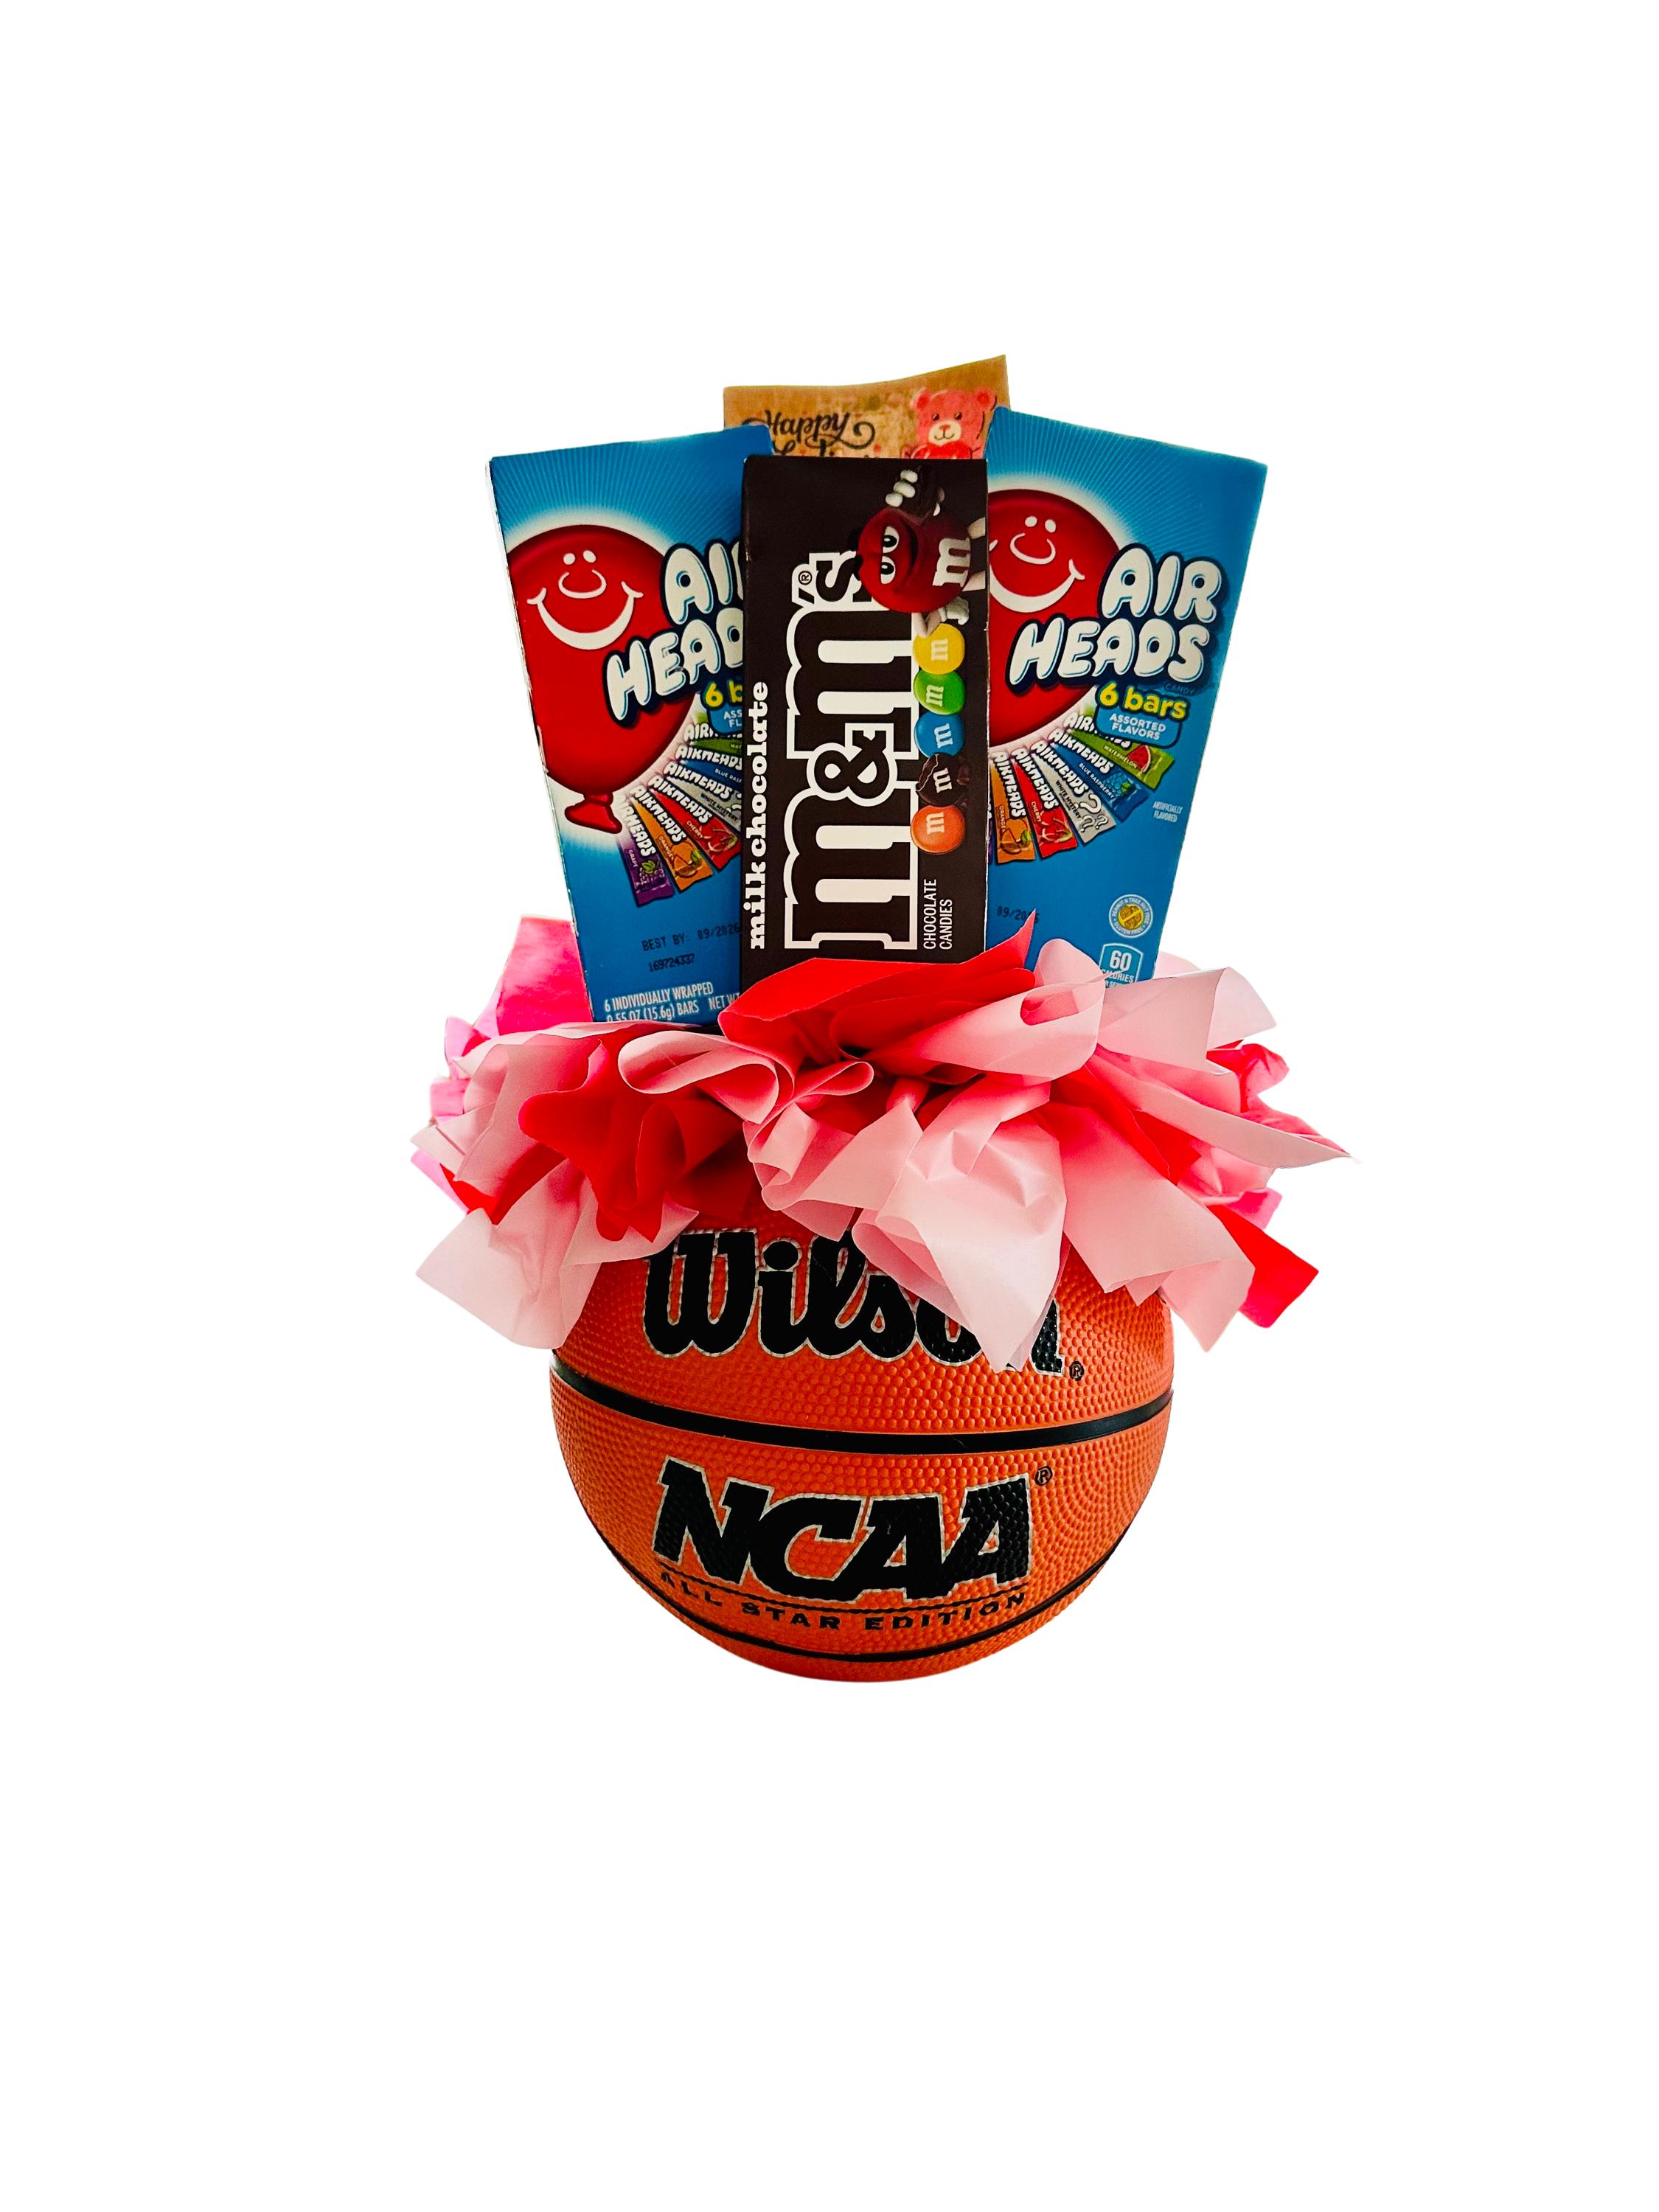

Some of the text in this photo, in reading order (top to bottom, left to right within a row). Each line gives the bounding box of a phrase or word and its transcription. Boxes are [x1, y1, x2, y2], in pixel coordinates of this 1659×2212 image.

[741, 408, 875, 449] Happy
[664, 542, 743, 625] AI
[1101, 546, 1222, 624] AIR
[606, 607, 743, 720] HEAD
[1009, 617, 1210, 686] HEADS
[706, 683, 723, 707] 6
[1099, 682, 1187, 720] 6 bars
[1164, 683, 1195, 695] CANDY
[1109, 713, 1166, 732] ASSORTED
[1111, 723, 1161, 740] FLAVORS
[1030, 740, 1090, 796] AIRHEADS
[1048, 728, 1114, 774] AIRHEADS
[1104, 745, 1138, 769] WATERMELON
[664, 761, 733, 799] AIRHEADS
[1010, 747, 1060, 810] AIRHEADS
[1079, 762, 1116, 799] BLUE RASPBERRY
[630, 785, 687, 843] AIRHEADS
[648, 775, 713, 824] AIRHEADS
[743, 681, 768, 950] milk chocolate
[1031, 801, 1042, 823] CHERRY
[687, 820, 704, 838] CHERRY
[922, 878, 937, 950] CHOCOLATE
[939, 898, 953, 950] CANDIES
[997, 905, 1040, 924] 09/20
[641, 936, 667, 951] BEST
[1109, 950, 1133, 972] 60
[604, 981, 714, 1013] 6 INDIVIDUALLY WRAPPED
[676, 999, 700, 1015] BARS
[708, 995, 726, 1010] NET
[643, 1228, 1064, 1376] Wilso
[651, 1454, 1032, 1605] NCAA
[661, 1571, 1026, 1632] ALL STAR EDITION
